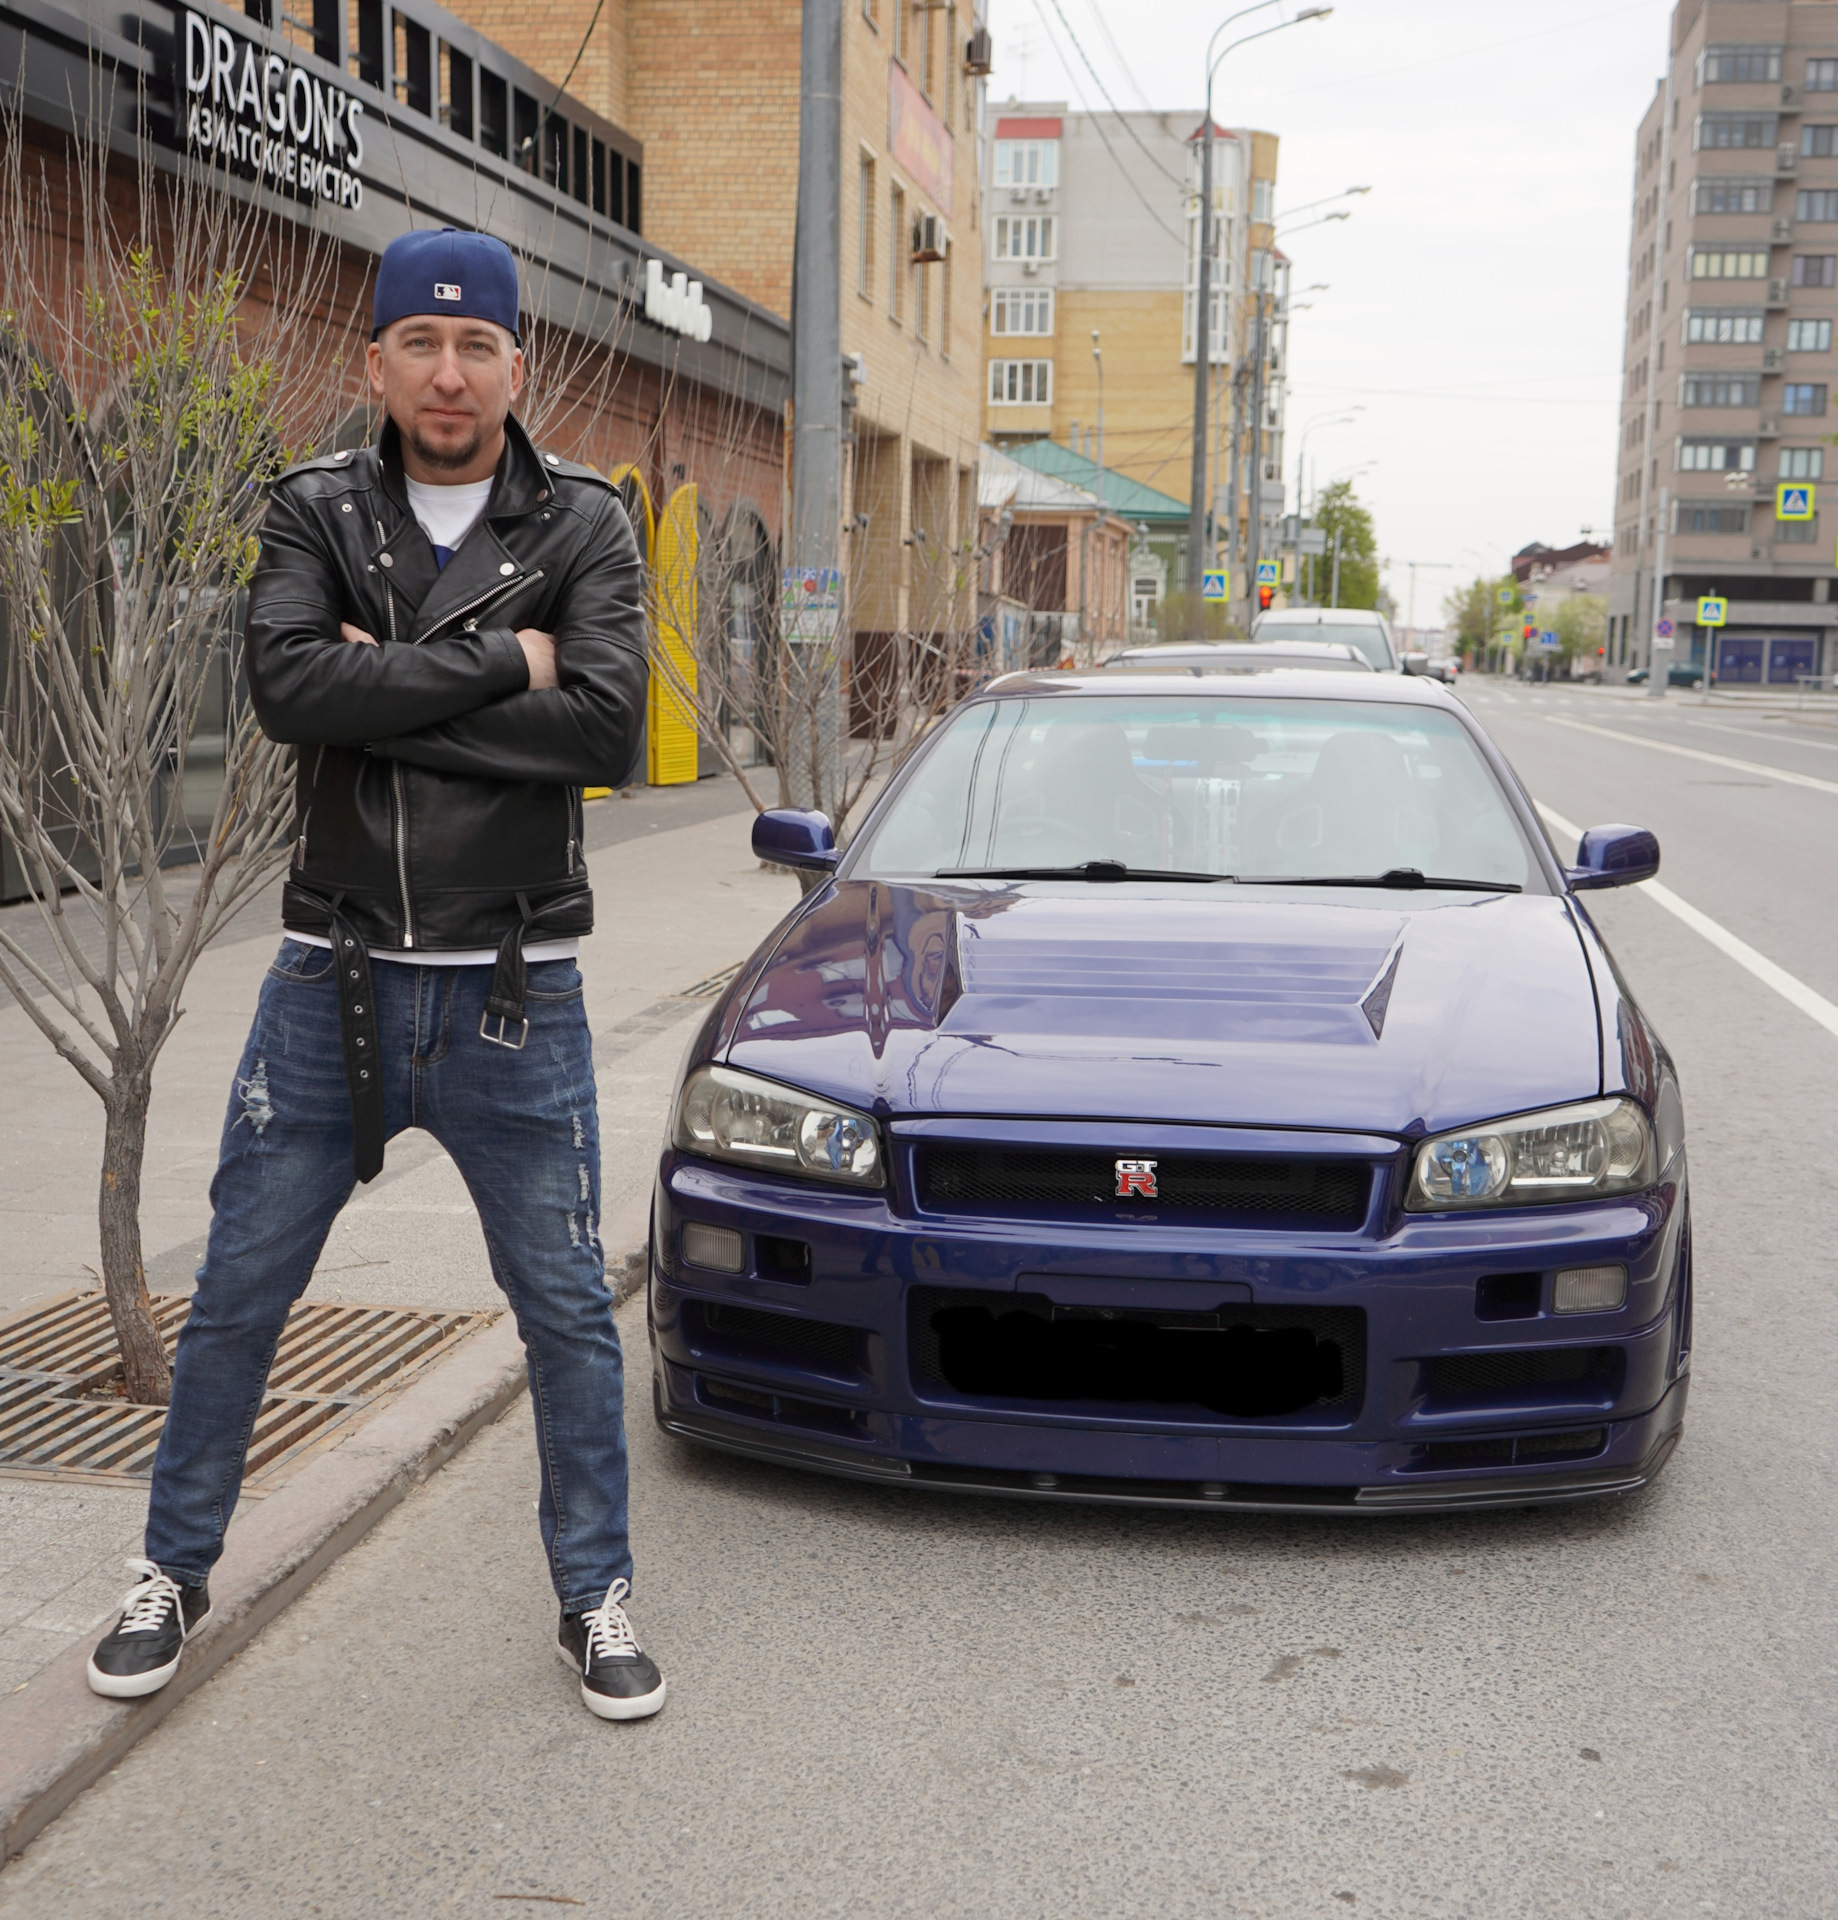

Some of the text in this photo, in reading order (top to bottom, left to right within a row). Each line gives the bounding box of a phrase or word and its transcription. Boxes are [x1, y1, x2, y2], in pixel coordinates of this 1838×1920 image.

[186, 10, 364, 168] DRAGON'S
[188, 103, 363, 211] АЗИАТСКОЕ БИСТРО
